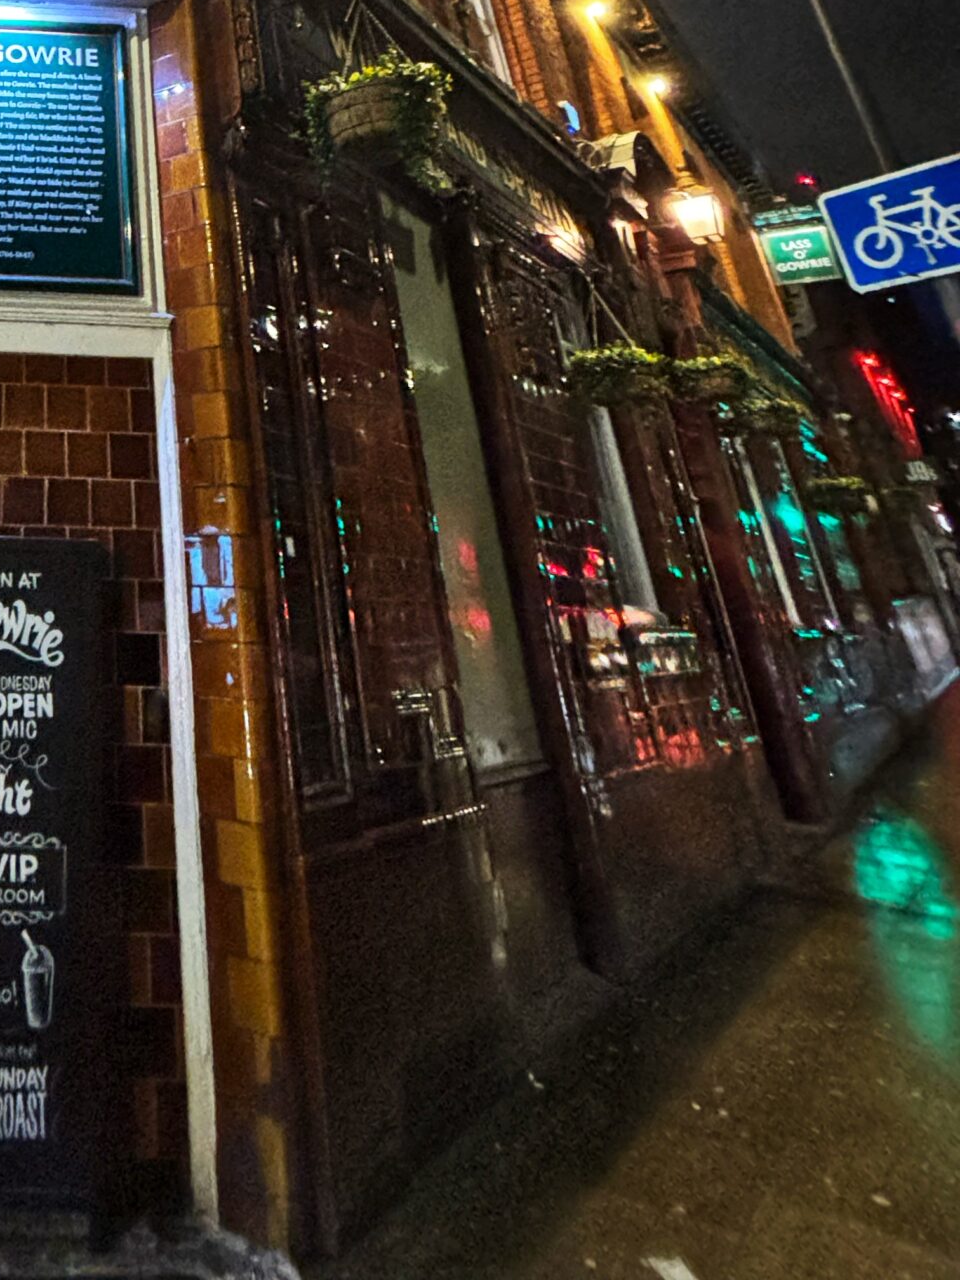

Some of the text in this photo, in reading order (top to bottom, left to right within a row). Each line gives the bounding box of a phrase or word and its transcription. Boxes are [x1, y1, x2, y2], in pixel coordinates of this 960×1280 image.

[780, 238, 812, 251] LASS
[793, 249, 808, 260] O'
[776, 257, 832, 272] GOWRIE
[18, 572, 42, 590] AT
[2, 719, 38, 740] MIC
